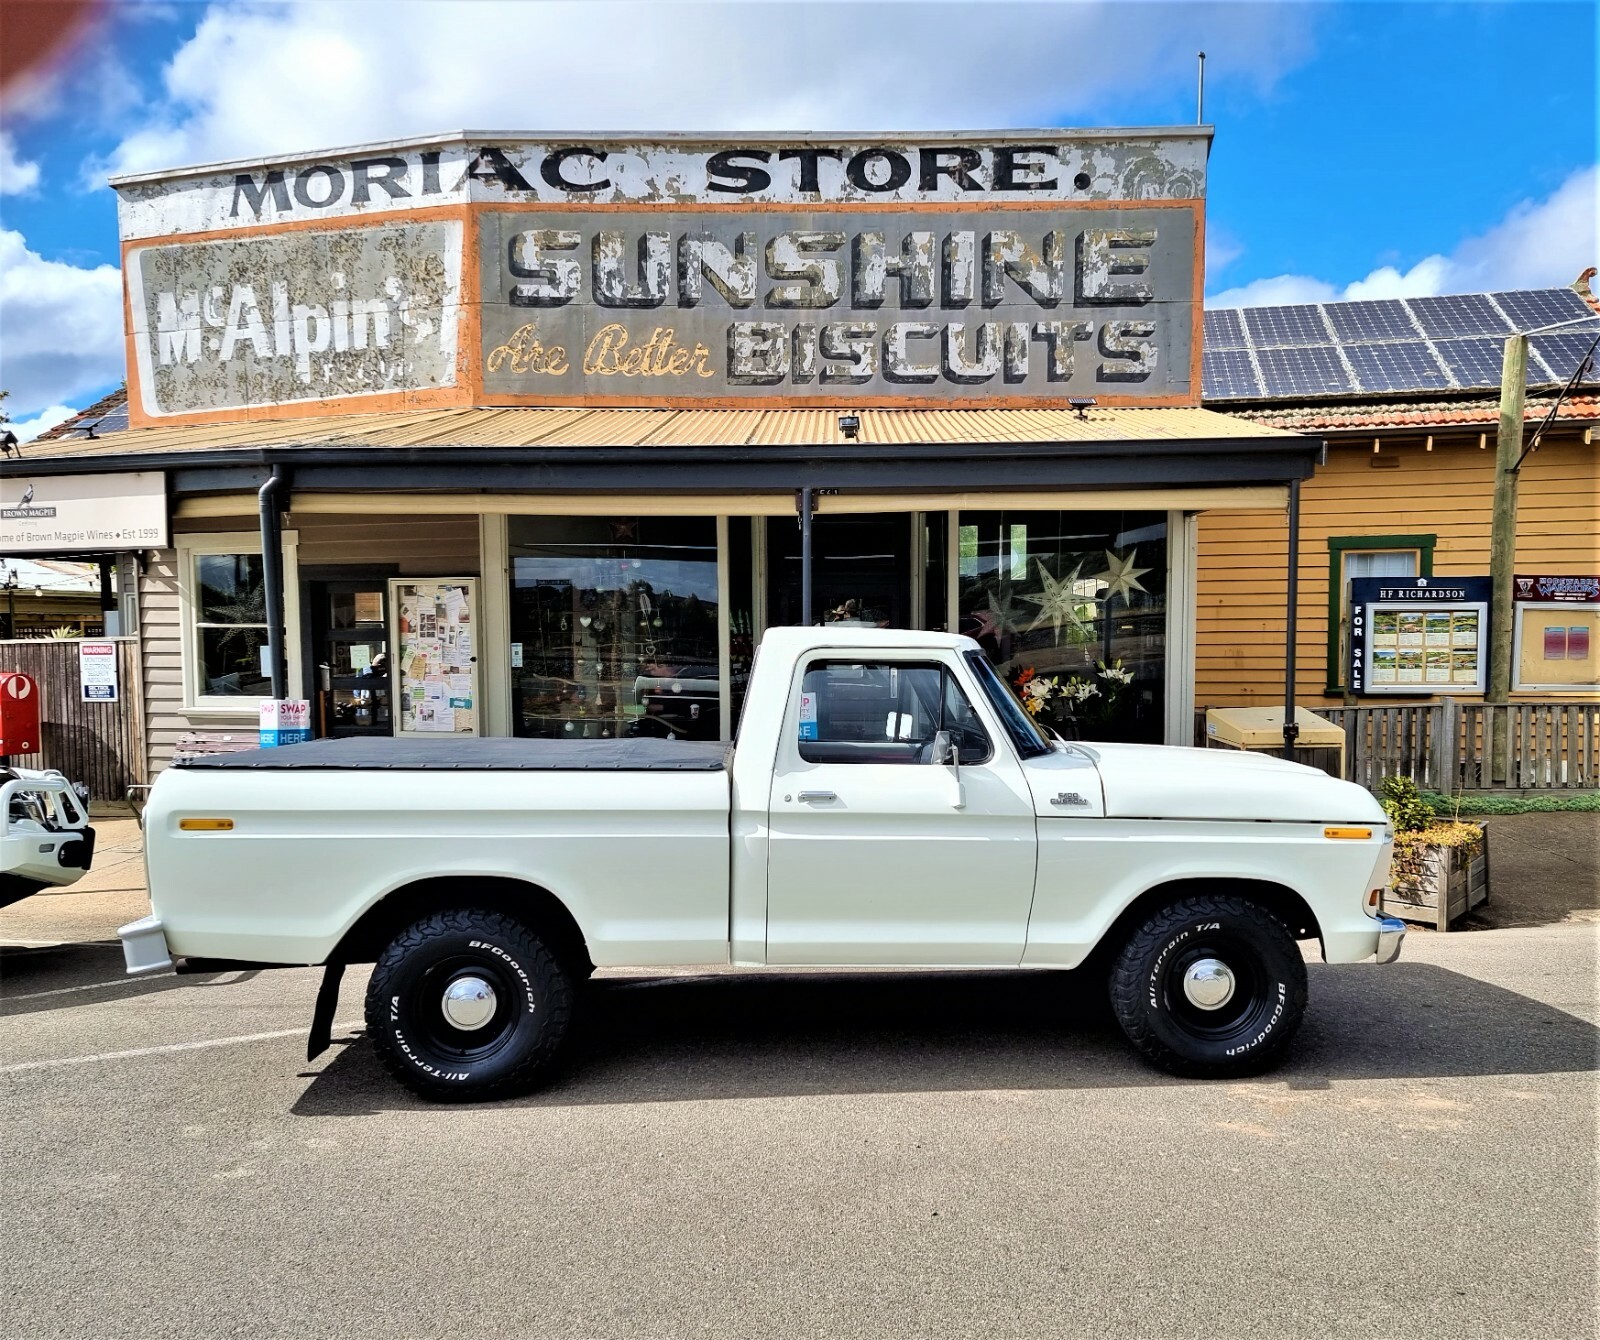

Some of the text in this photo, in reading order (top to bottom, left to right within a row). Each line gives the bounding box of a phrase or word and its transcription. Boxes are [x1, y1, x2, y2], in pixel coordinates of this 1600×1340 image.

[230, 146, 611, 218] MORIAC
[509, 228, 1158, 309] SUNSHINE
[487, 320, 1158, 386] Are Better BISCUITS
[2, 508, 56, 518] BROWN MAGPIE
[16, 532, 25, 542] of
[26, 532, 52, 542] Brown
[54, 530, 85, 543] Magpie
[87, 529, 114, 540] Wines
[122, 528, 136, 539] Est
[138, 528, 159, 539] 1999
[1379, 589, 1466, 599] HF RICHARDSON
[1535, 583, 1600, 598] WARRIORS
[1354, 606, 1363, 637] FOR
[82, 646, 112, 654] WARNING
[1353, 648, 1362, 689] SALE
[280, 703, 306, 714] SWAP
[280, 733, 306, 744] HERE
[1195, 922, 1221, 932] T/A
[468, 940, 536, 1014] BFGoodrich
[390, 995, 400, 1022] T/A
[1226, 982, 1286, 1057] BFGoodrich
